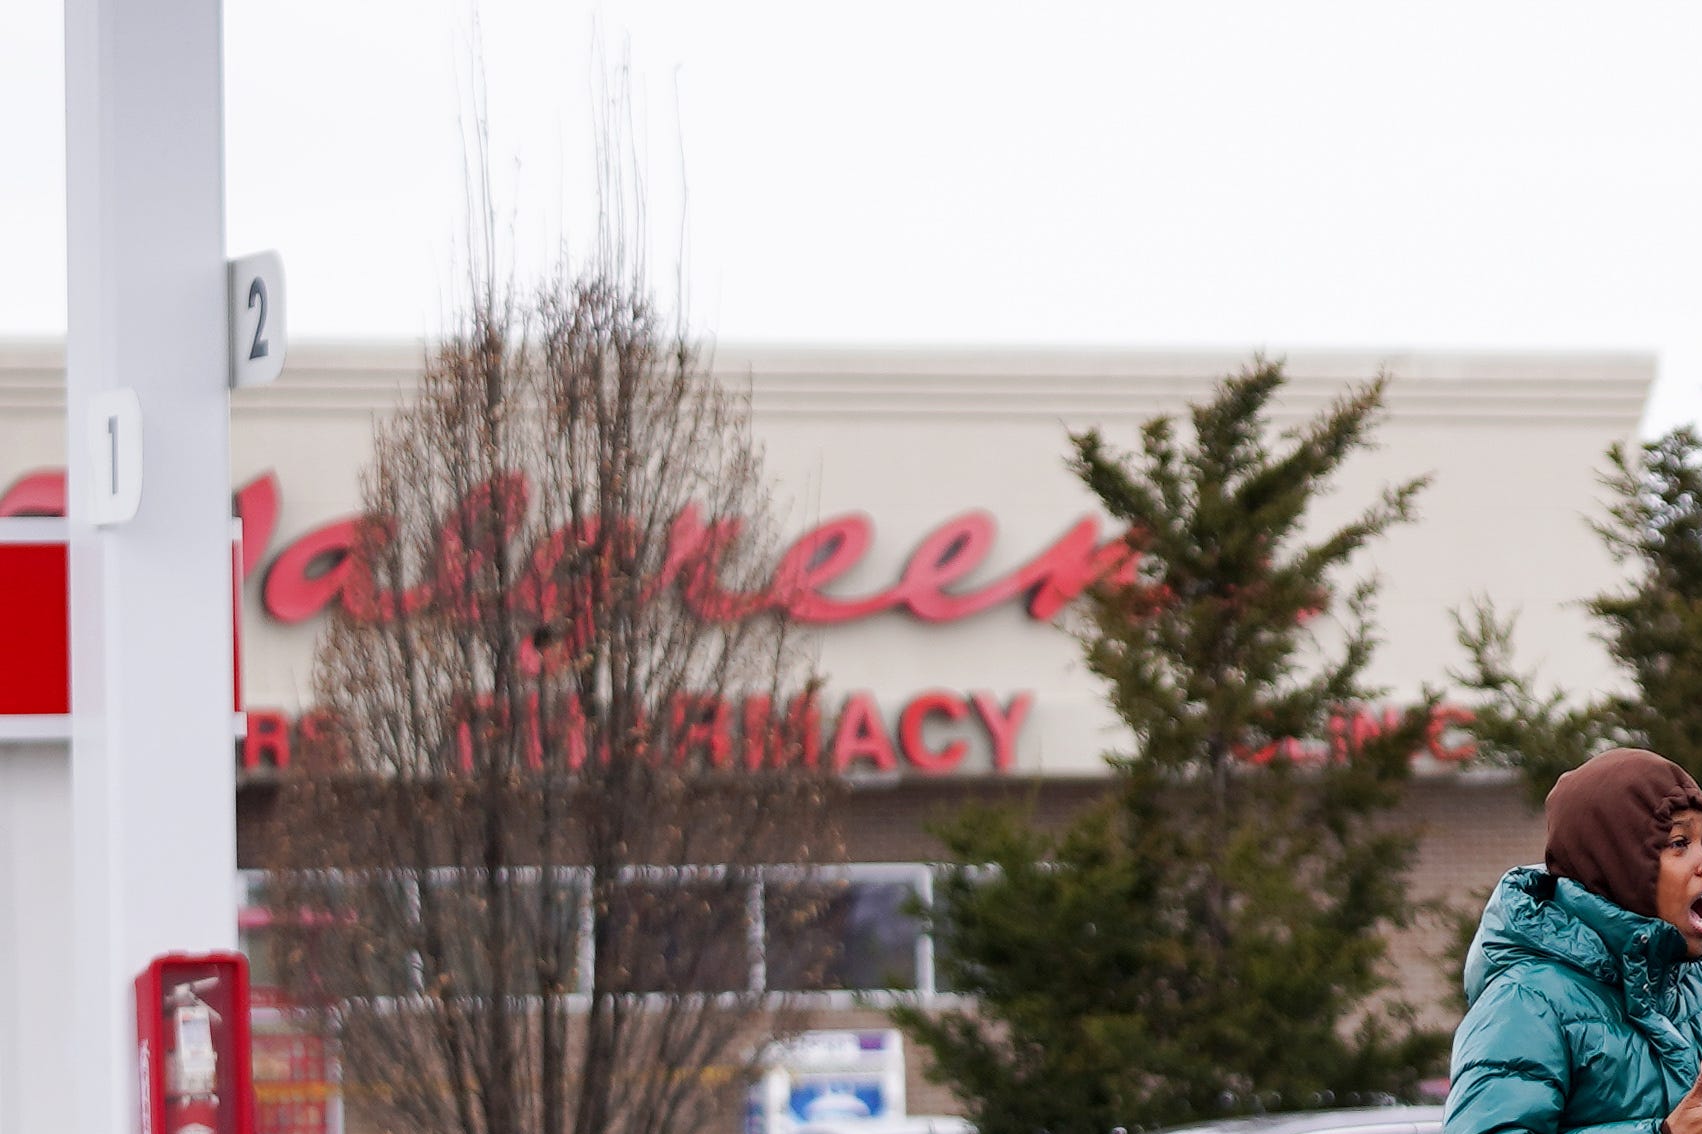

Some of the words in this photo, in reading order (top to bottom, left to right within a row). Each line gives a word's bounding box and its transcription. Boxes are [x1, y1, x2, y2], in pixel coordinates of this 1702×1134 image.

[248, 276, 269, 361] 2
[107, 415, 119, 495] 1
[0, 463, 1332, 676] algreen
